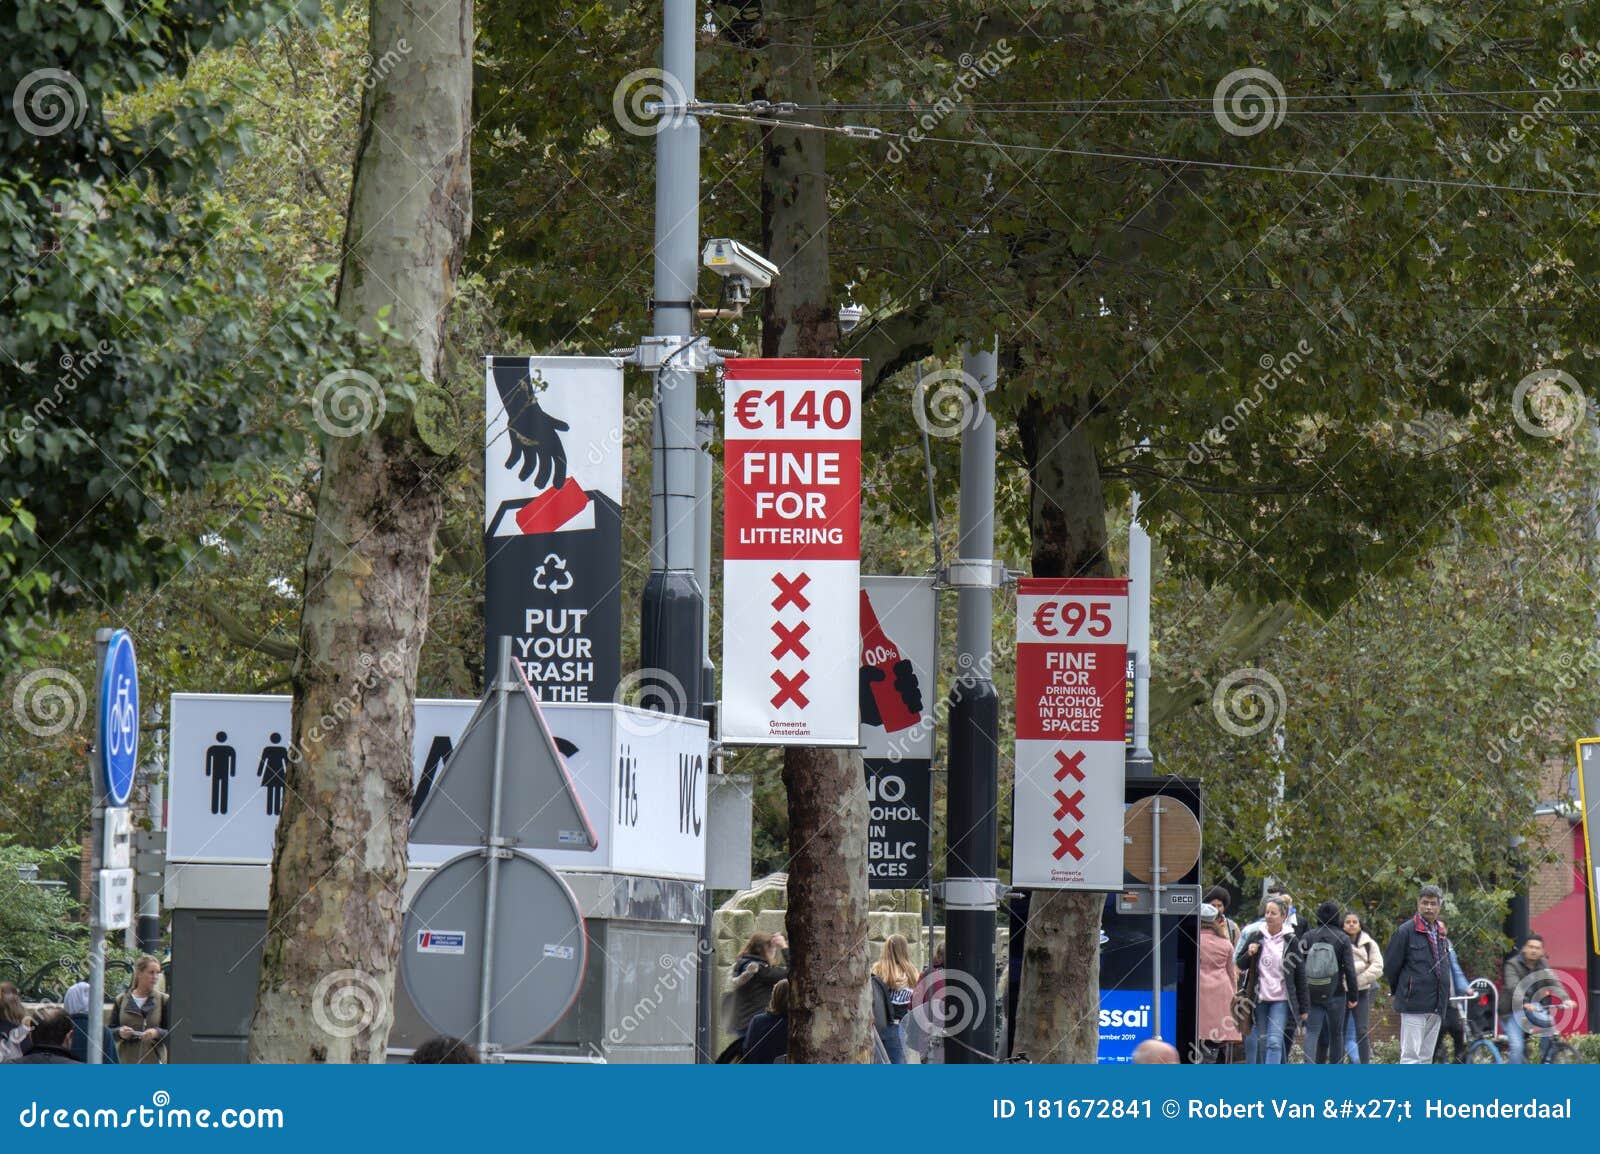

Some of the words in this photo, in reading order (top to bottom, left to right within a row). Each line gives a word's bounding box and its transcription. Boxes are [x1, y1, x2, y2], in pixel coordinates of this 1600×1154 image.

[733, 389, 852, 430] €140
[743, 452, 841, 485] FINE
[756, 491, 827, 520] FOR
[740, 527, 843, 545] LITTERING
[525, 608, 588, 635] PUT
[1032, 601, 1112, 638] €95
[515, 637, 592, 658] YOUR
[1046, 652, 1097, 670] FINE
[1052, 670, 1089, 686] FOR
[548, 685, 589, 702] THE
[1046, 686, 1097, 695] DRINKING
[1038, 695, 1104, 707] ALCOHOL
[1039, 707, 1053, 718] IN
[1057, 707, 1102, 719] PUBLIC
[769, 719, 807, 728] Gemeente
[769, 728, 811, 736] Amsterdam
[1042, 719, 1100, 732] SPACES
[679, 752, 703, 837] WC
[1121, 1032, 1137, 1041] 2019
